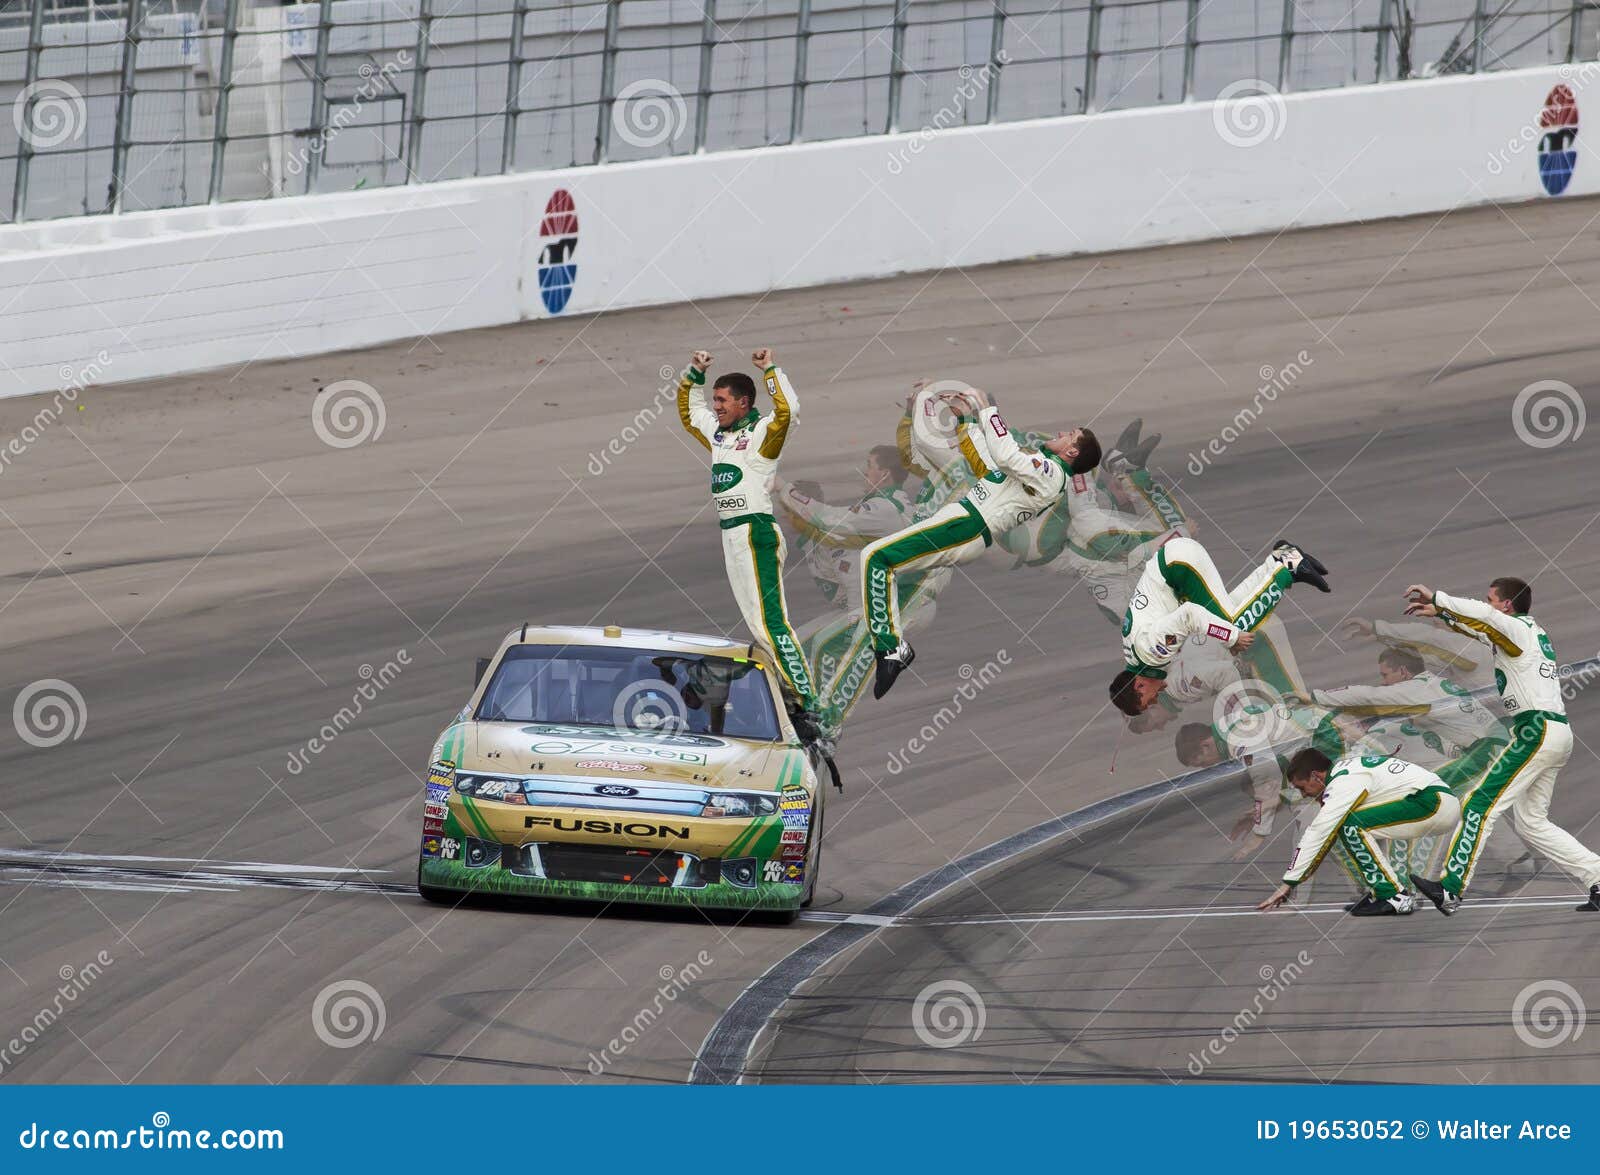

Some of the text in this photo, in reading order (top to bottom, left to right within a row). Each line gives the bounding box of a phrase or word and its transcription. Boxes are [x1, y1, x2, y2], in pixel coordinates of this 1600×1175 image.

[870, 567, 890, 635] Scotts
[776, 634, 813, 695] Scotts
[601, 784, 631, 797] Ford
[524, 815, 690, 840] FUSION
[781, 815, 809, 827] MAHLE
[1449, 808, 1481, 880] Scotts
[1343, 825, 1387, 885] Scotts
